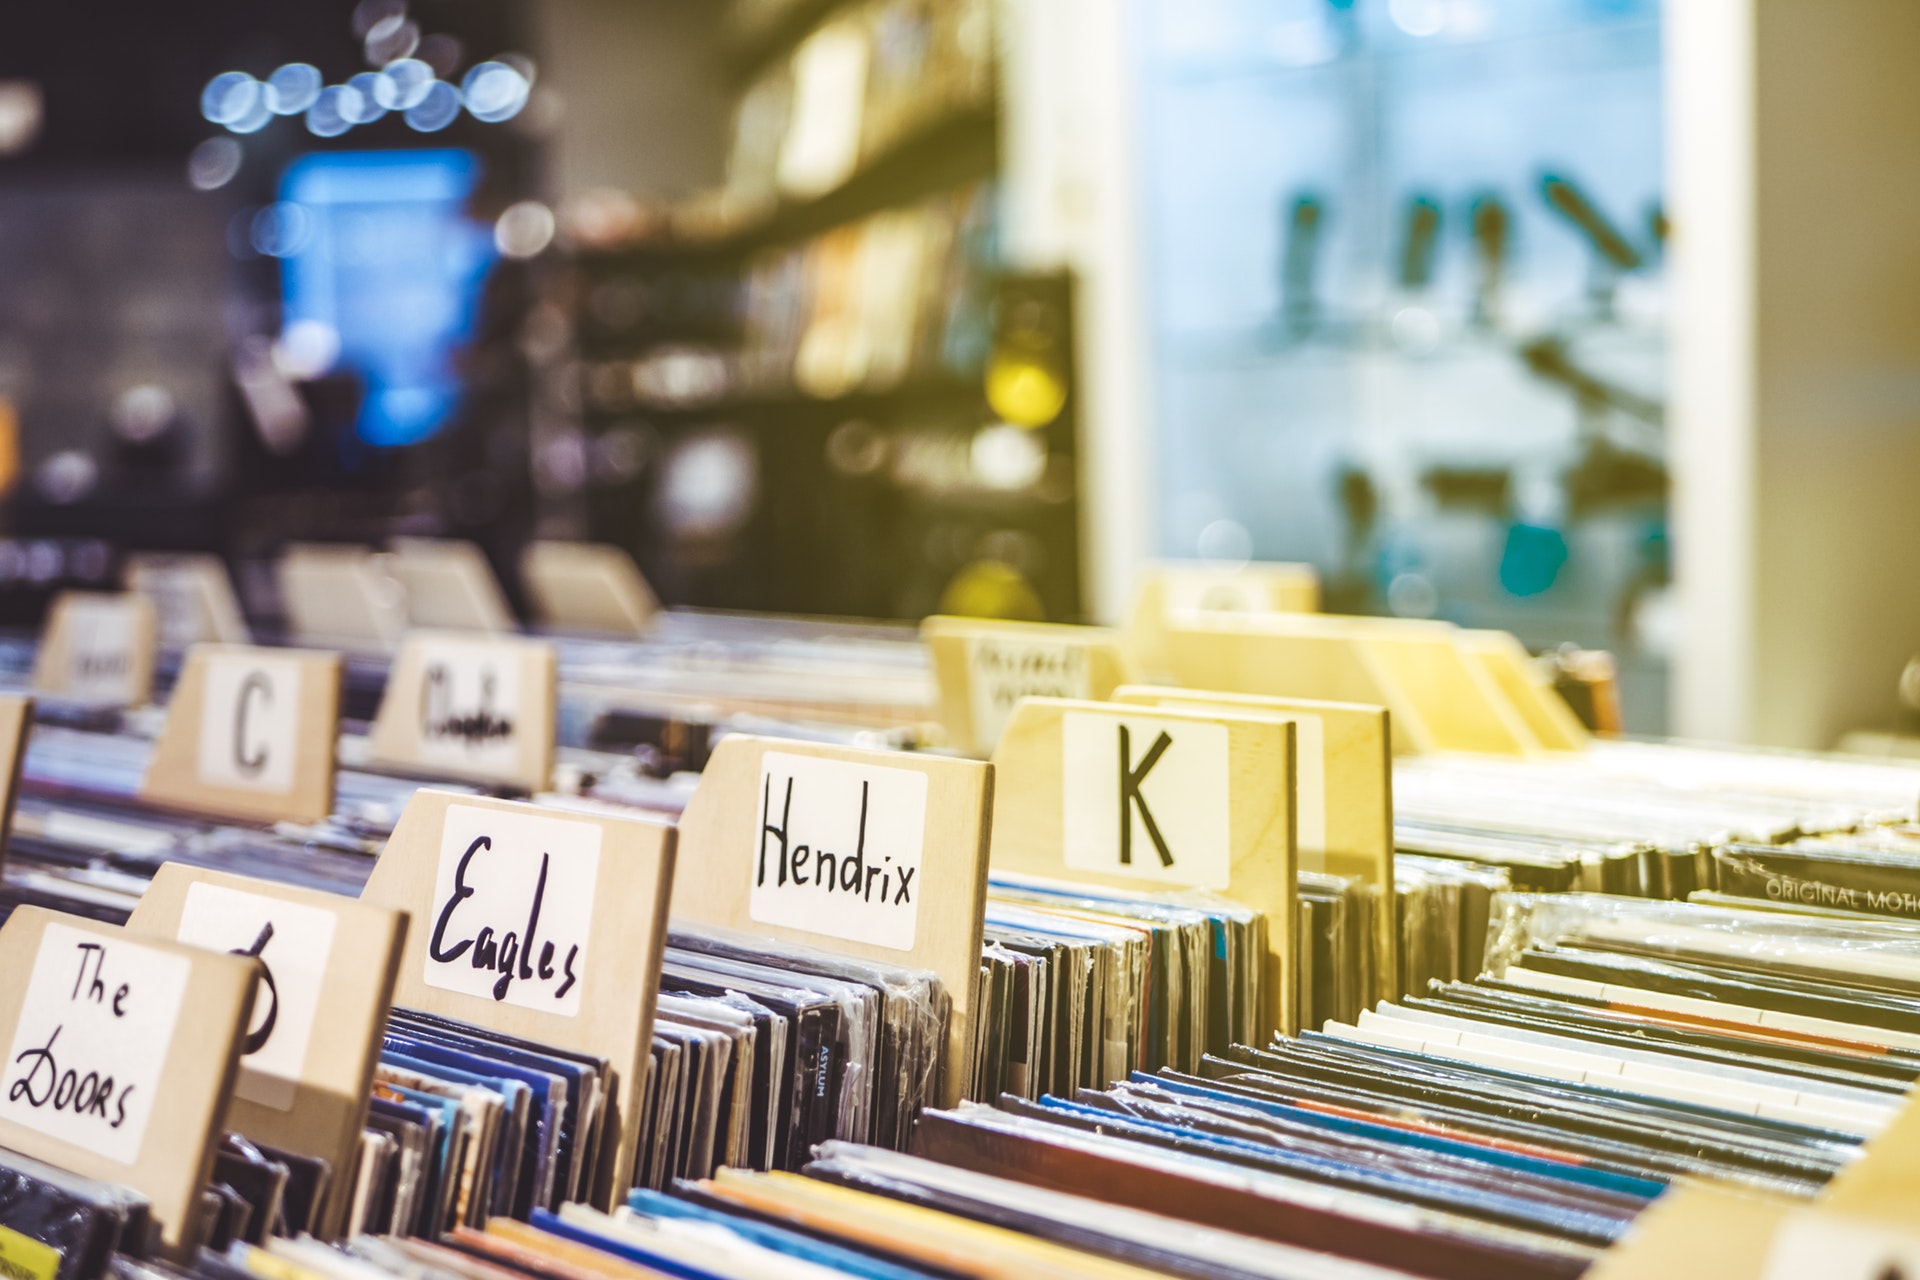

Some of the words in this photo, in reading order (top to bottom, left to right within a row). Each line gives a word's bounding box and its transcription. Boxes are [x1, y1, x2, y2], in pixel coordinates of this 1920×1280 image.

[232, 669, 275, 779] C
[757, 772, 915, 906] Hendrix
[1119, 723, 1174, 867] K
[430, 835, 579, 1001] Eagles
[1765, 878, 1861, 909] ORIGINAL
[1867, 889, 1920, 913] MOTI
[71, 942, 130, 1018] The
[816, 1045, 829, 1097] ASYLUM
